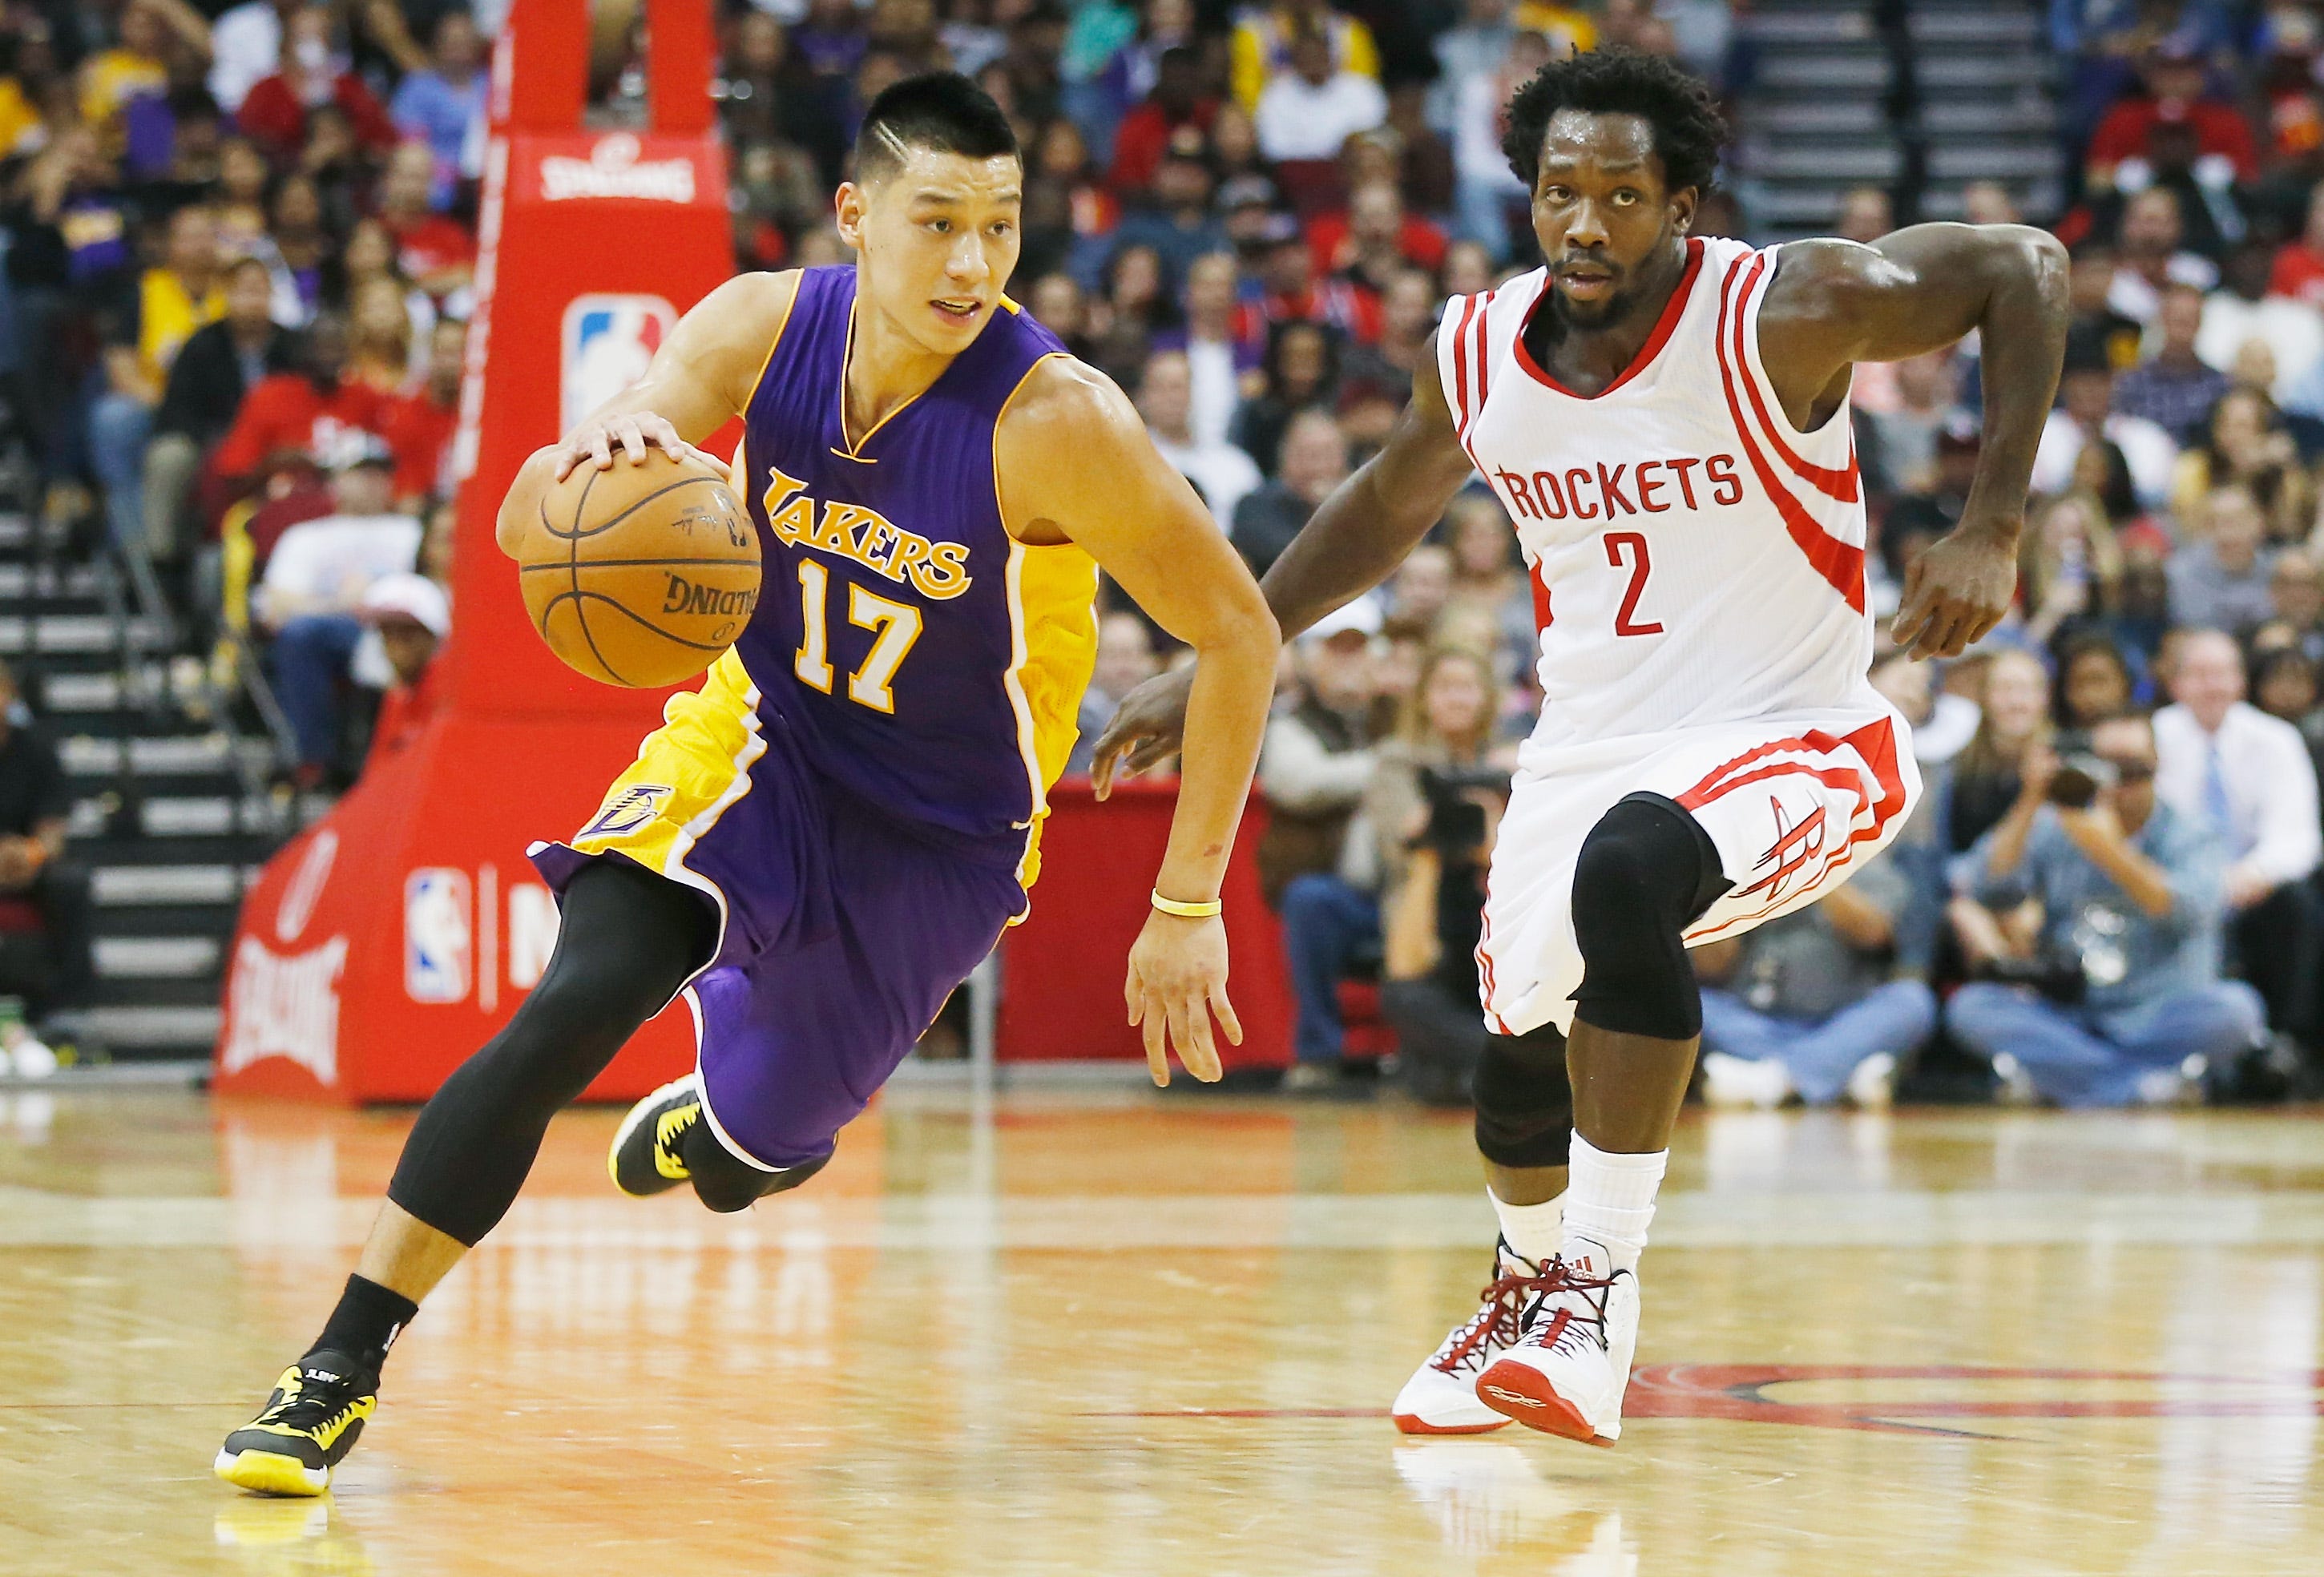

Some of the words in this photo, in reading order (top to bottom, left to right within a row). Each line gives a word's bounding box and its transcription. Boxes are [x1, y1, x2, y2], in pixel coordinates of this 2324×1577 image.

[1495, 454, 1743, 521] ROCKETS
[763, 466, 973, 600] LAKERS
[664, 572, 758, 615] ALDING
[1604, 532, 1664, 636] 2
[794, 557, 923, 715] 17
[1567, 1266, 1597, 1281] didas
